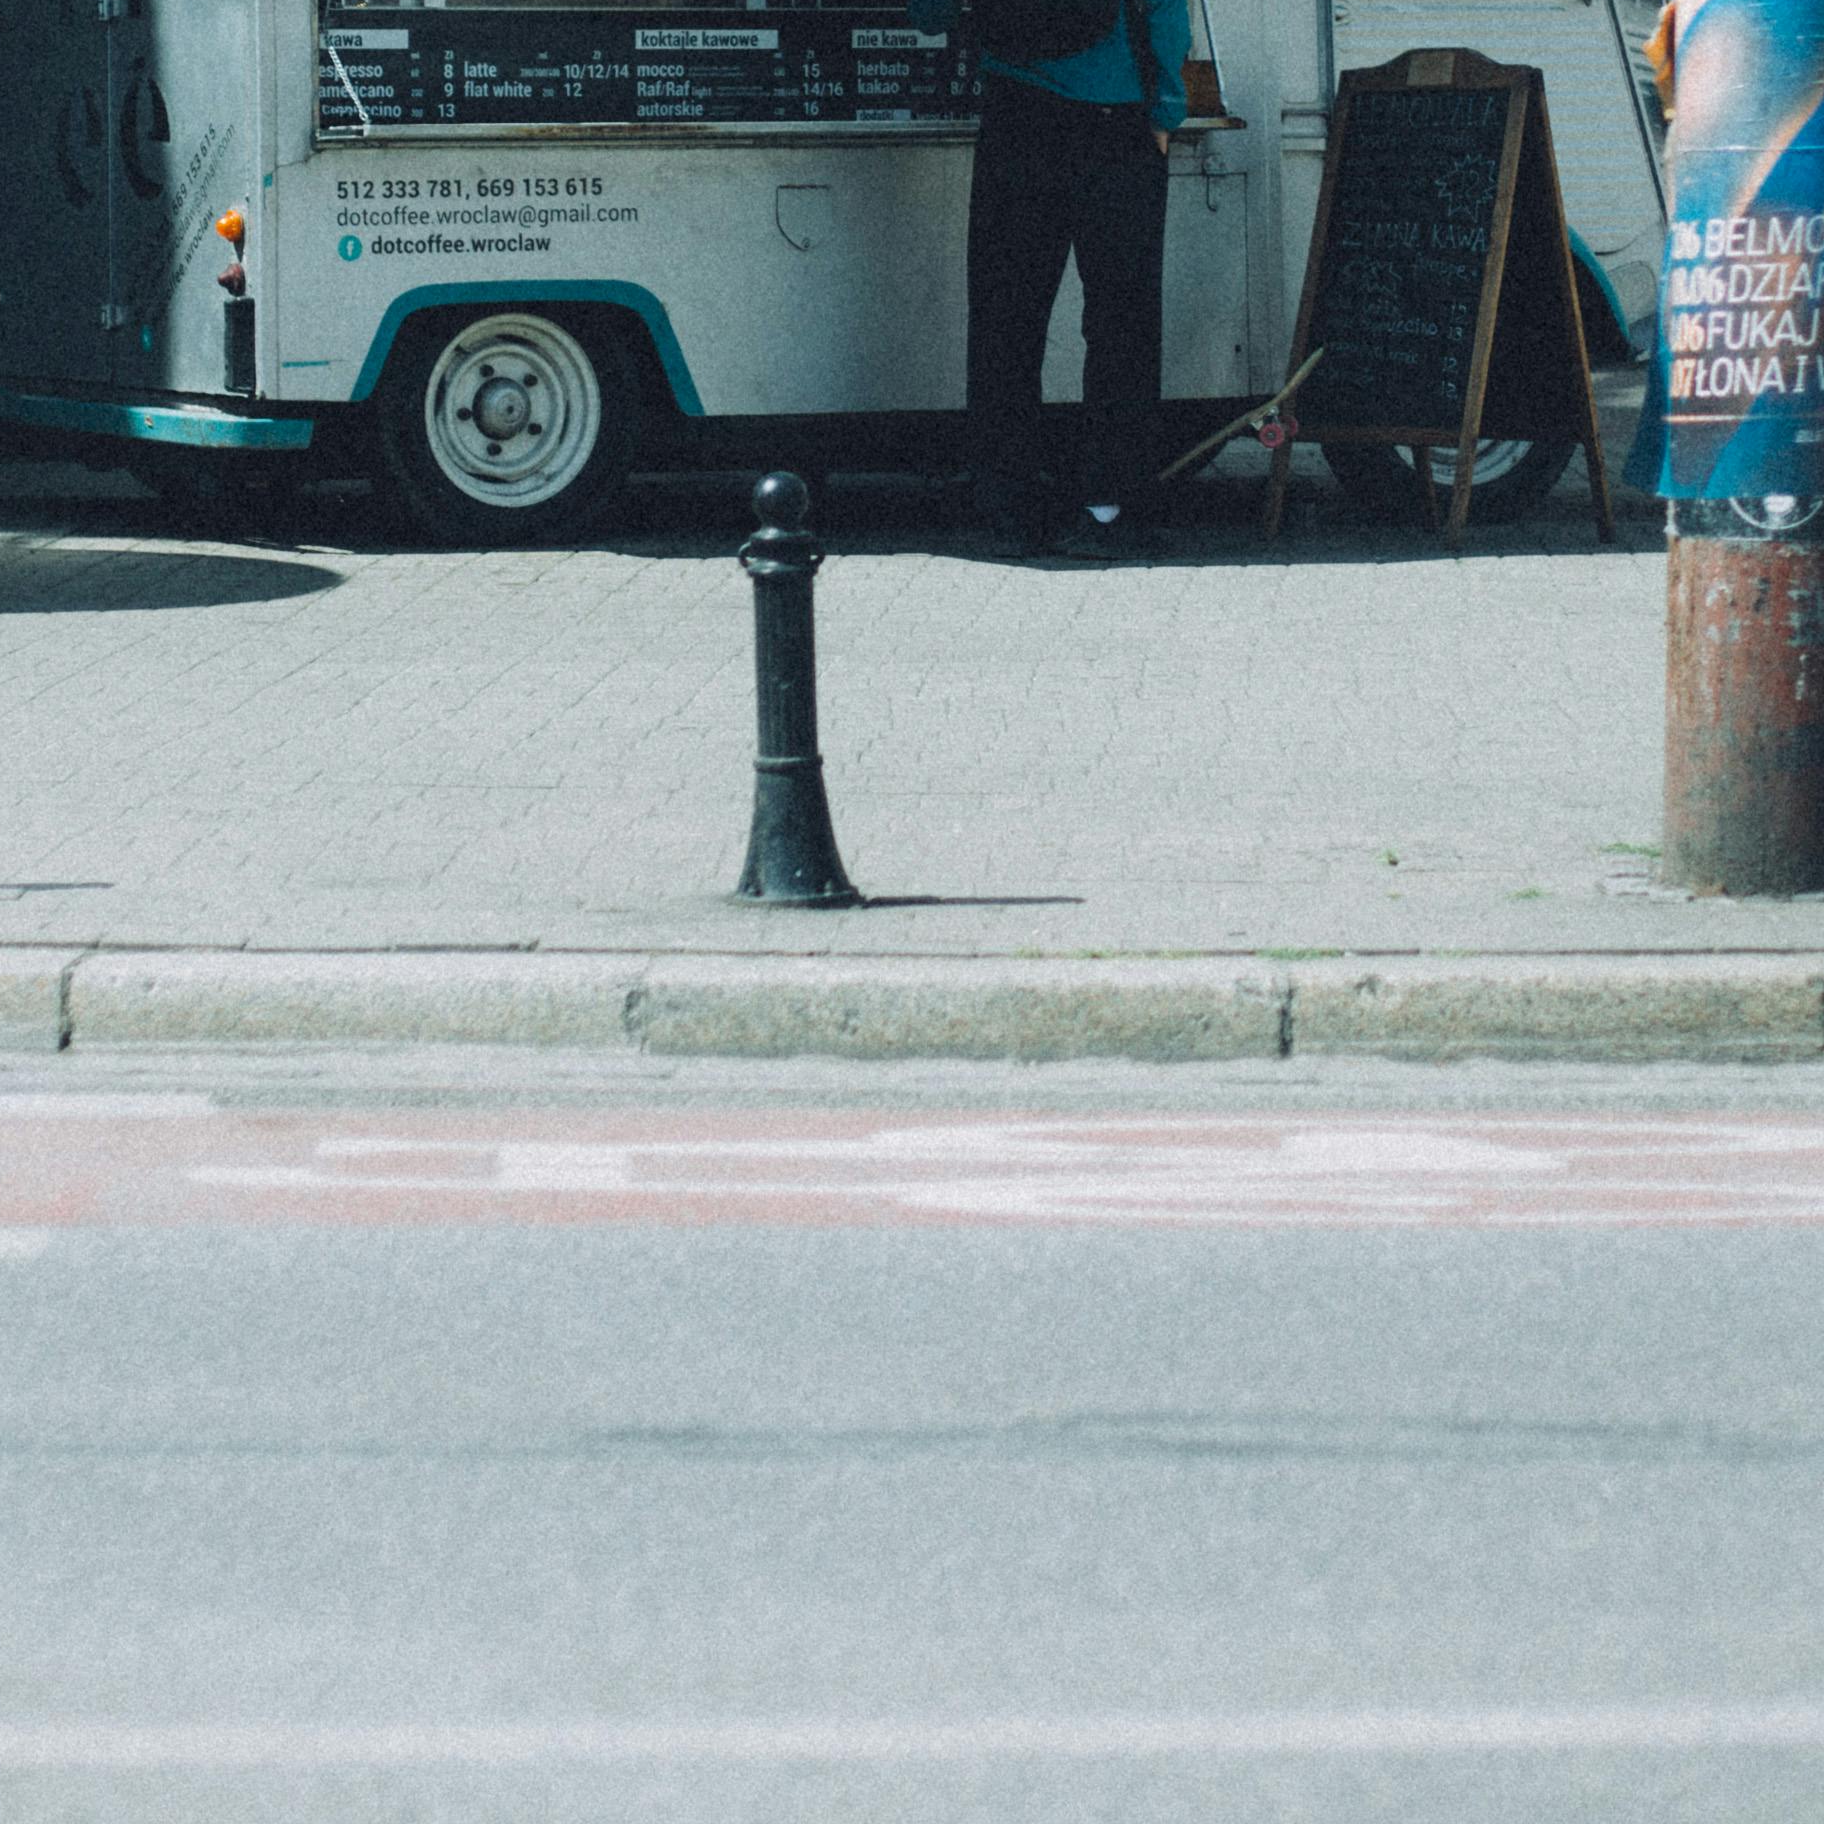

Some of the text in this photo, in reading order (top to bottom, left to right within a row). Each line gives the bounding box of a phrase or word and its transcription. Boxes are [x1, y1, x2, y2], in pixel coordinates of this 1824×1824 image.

[324, 33, 363, 47] kawa
[641, 30, 758, 49] koktajle kawowe
[857, 30, 918, 46] nie kawa
[444, 63, 454, 79] 8
[464, 61, 497, 78] latte
[564, 64, 629, 79] 10/12/14
[637, 64, 684, 78] mocco
[802, 63, 821, 78] 15
[957, 62, 966, 77] 8
[319, 81, 394, 98] ameicano
[444, 82, 454, 98] 9
[464, 81, 488, 97] flat
[492, 81, 532, 97] white
[564, 82, 583, 97] 12
[637, 81, 690, 97] Raf/Raf
[802, 81, 844, 97] 14/16
[857, 78, 900, 94] kakao
[437, 103, 456, 118] 13
[637, 100, 703, 116] autorskie
[803, 101, 820, 116] 16
[337, 177, 603, 201] 512 333 781, 669 153 615
[337, 204, 639, 227] dotcoffee.wroclaw@gmail.com
[371, 234, 551, 254] dotcoffee.wroclaw
[1707, 308, 1820, 350] FUKAJ
[1695, 356, 1785, 397] ŁONA
[1793, 355, 1809, 393] I
